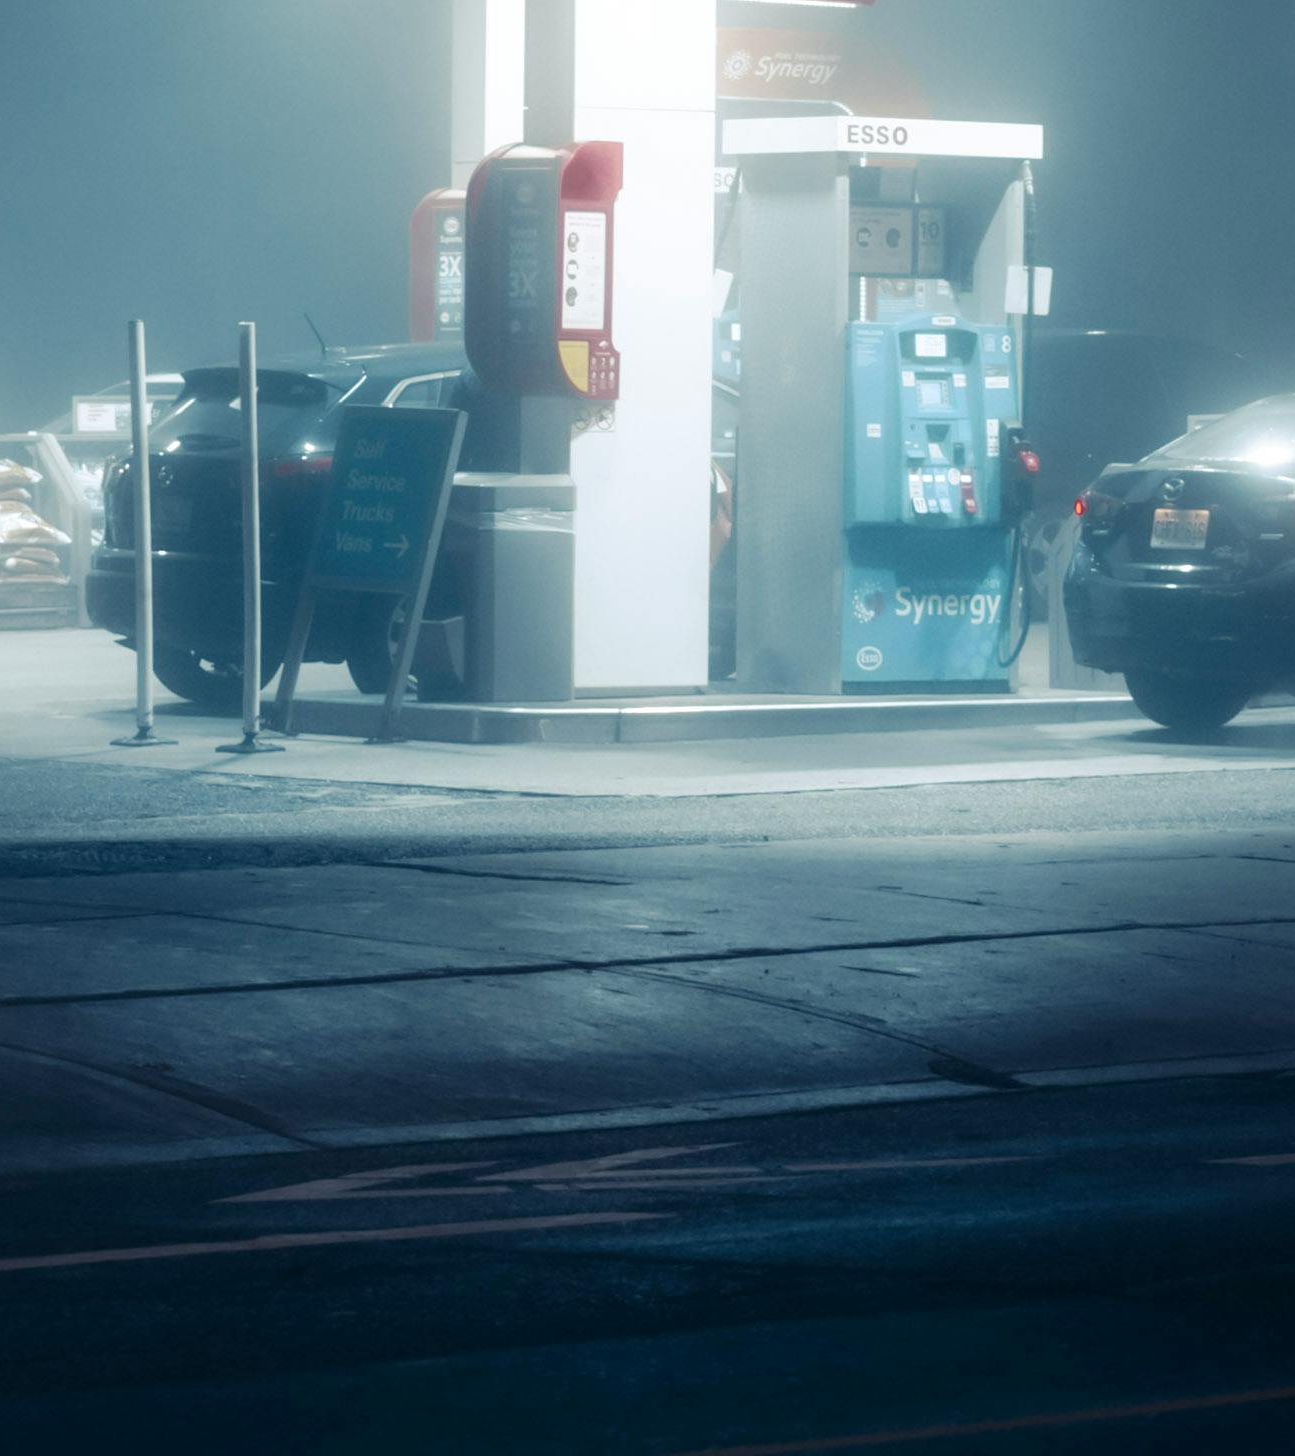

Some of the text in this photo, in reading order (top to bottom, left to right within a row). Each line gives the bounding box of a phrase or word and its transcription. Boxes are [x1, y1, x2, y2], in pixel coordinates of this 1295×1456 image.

[754, 56, 837, 85] Synergy
[847, 124, 908, 146] ESSO
[439, 255, 462, 277] 3X
[509, 271, 539, 297] 3X
[1001, 335, 1012, 352] 8
[354, 438, 388, 459] Self
[347, 468, 407, 492] Service
[342, 499, 395, 523] Trucks
[336, 530, 373, 553] Vans
[895, 586, 1001, 624] Synergy
